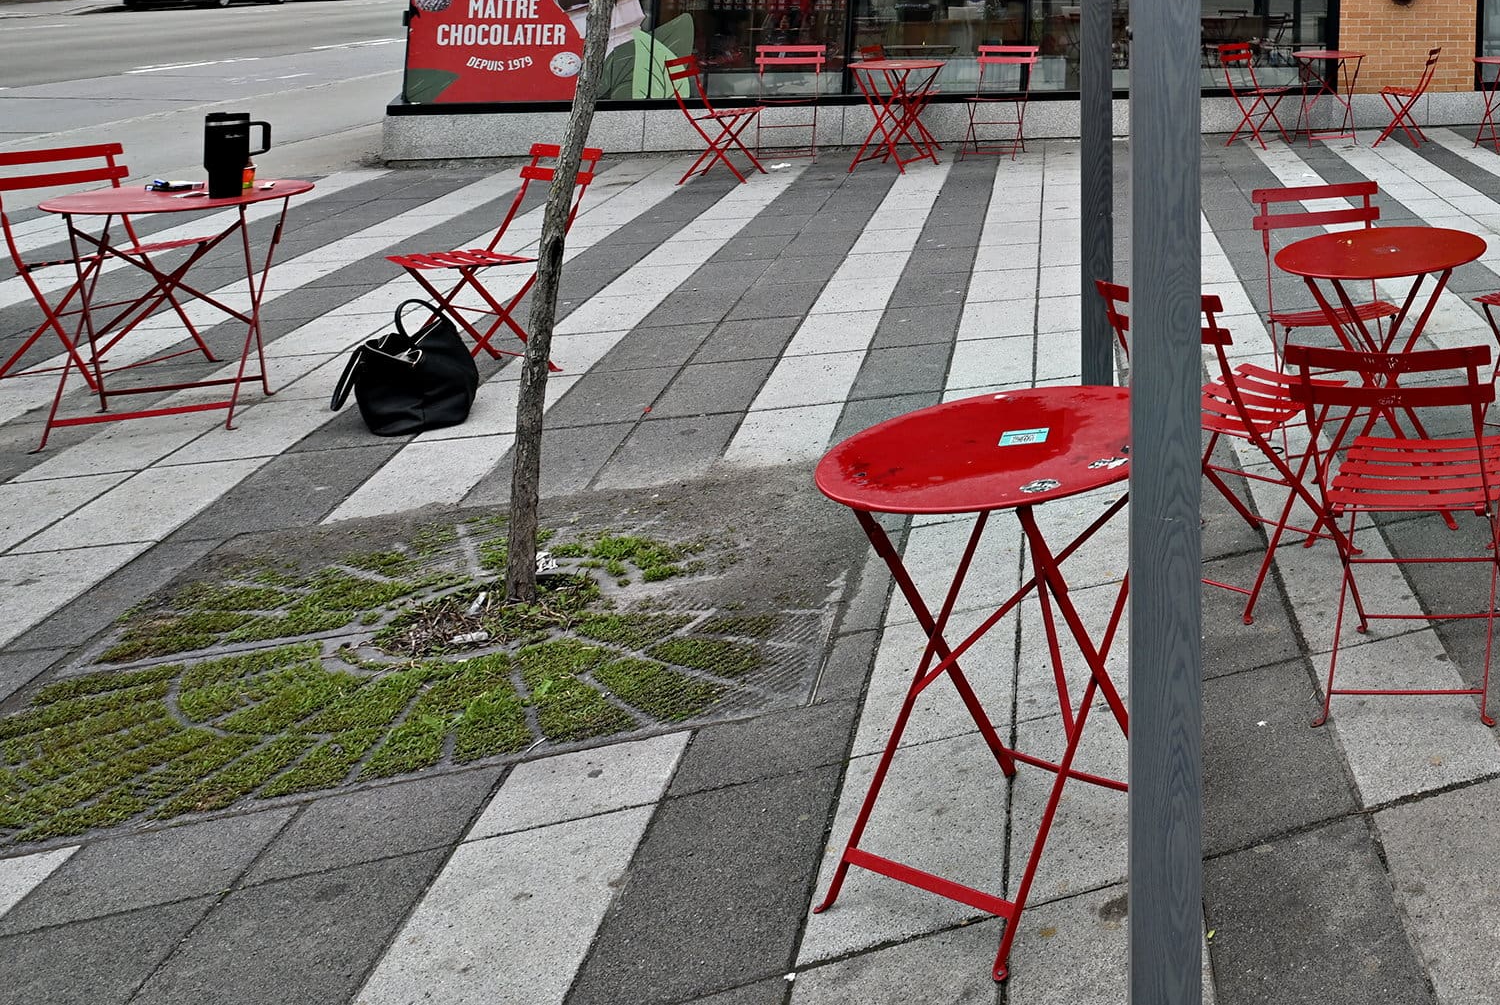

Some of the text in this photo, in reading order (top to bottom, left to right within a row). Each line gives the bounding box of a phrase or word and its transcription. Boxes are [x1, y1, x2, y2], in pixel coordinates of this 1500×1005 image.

[437, 24, 566, 46] CHOCOLATIER
[466, 56, 533, 71] DEPUIS 1979
